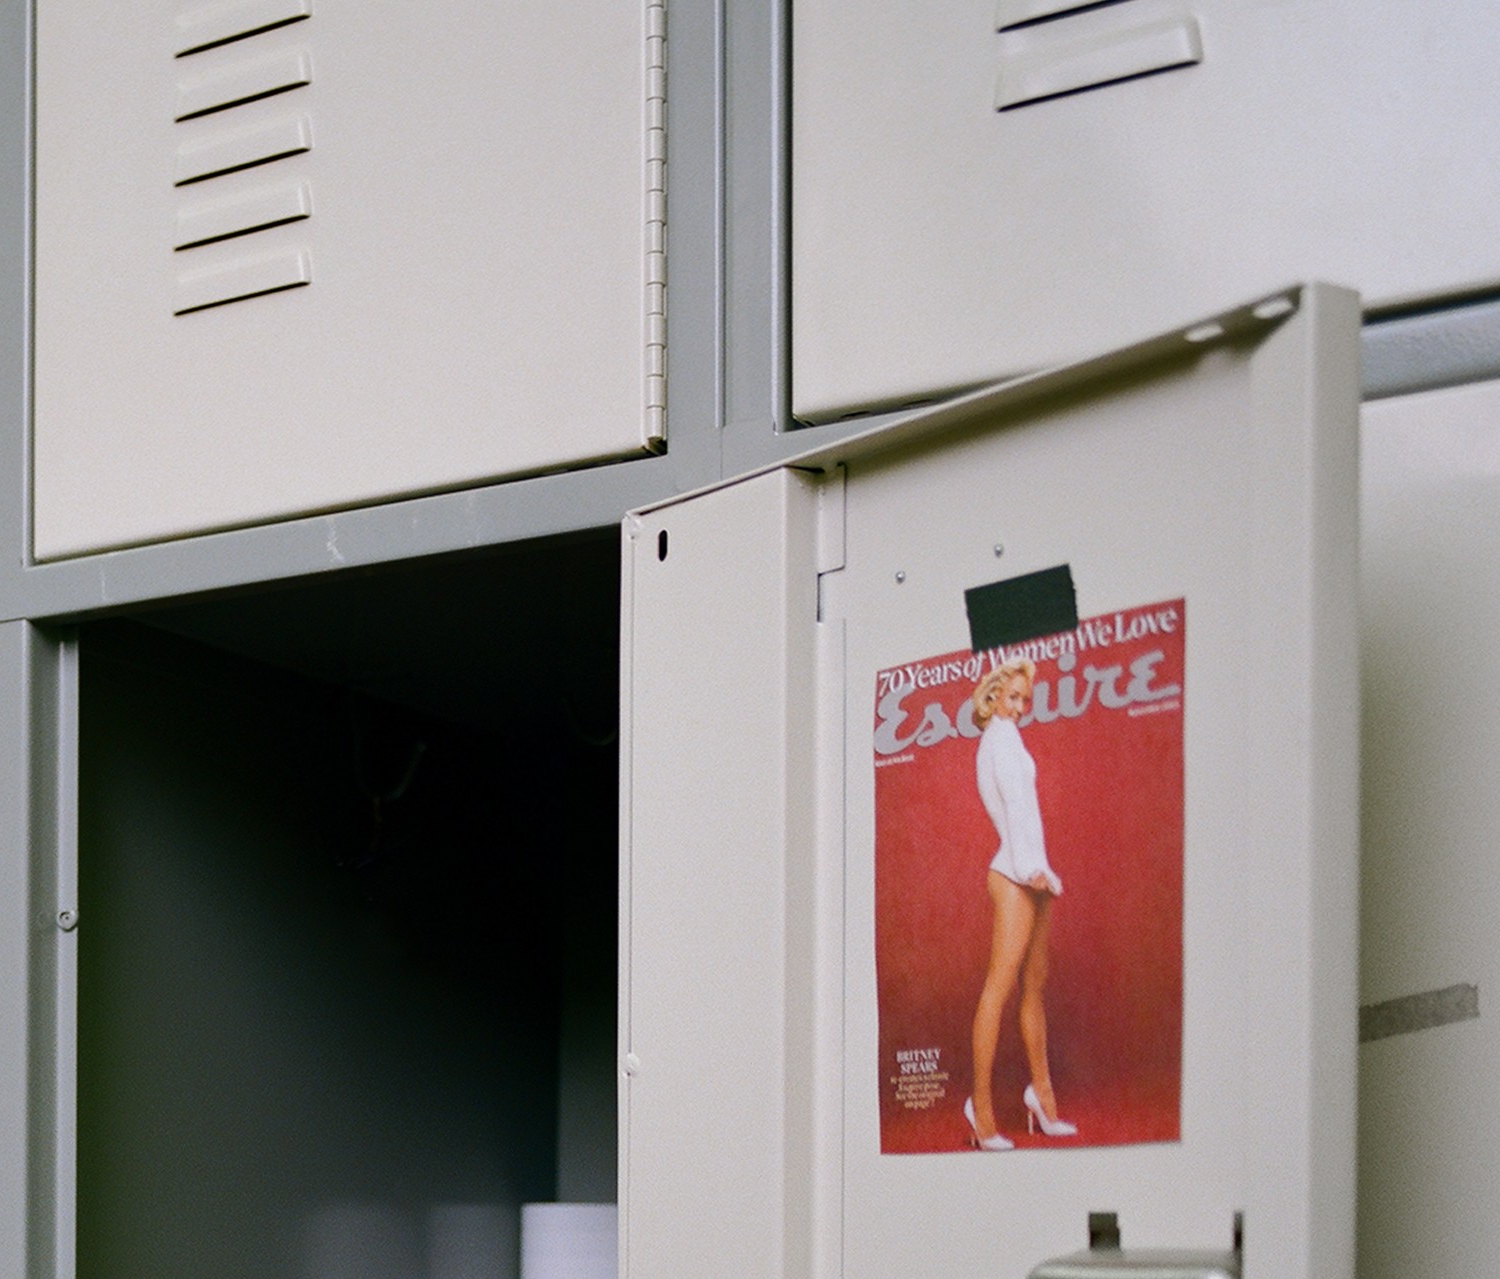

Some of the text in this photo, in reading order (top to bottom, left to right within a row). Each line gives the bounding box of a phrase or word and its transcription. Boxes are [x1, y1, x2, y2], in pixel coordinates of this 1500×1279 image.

[879, 607, 1179, 698] 70 Years of Women We Love
